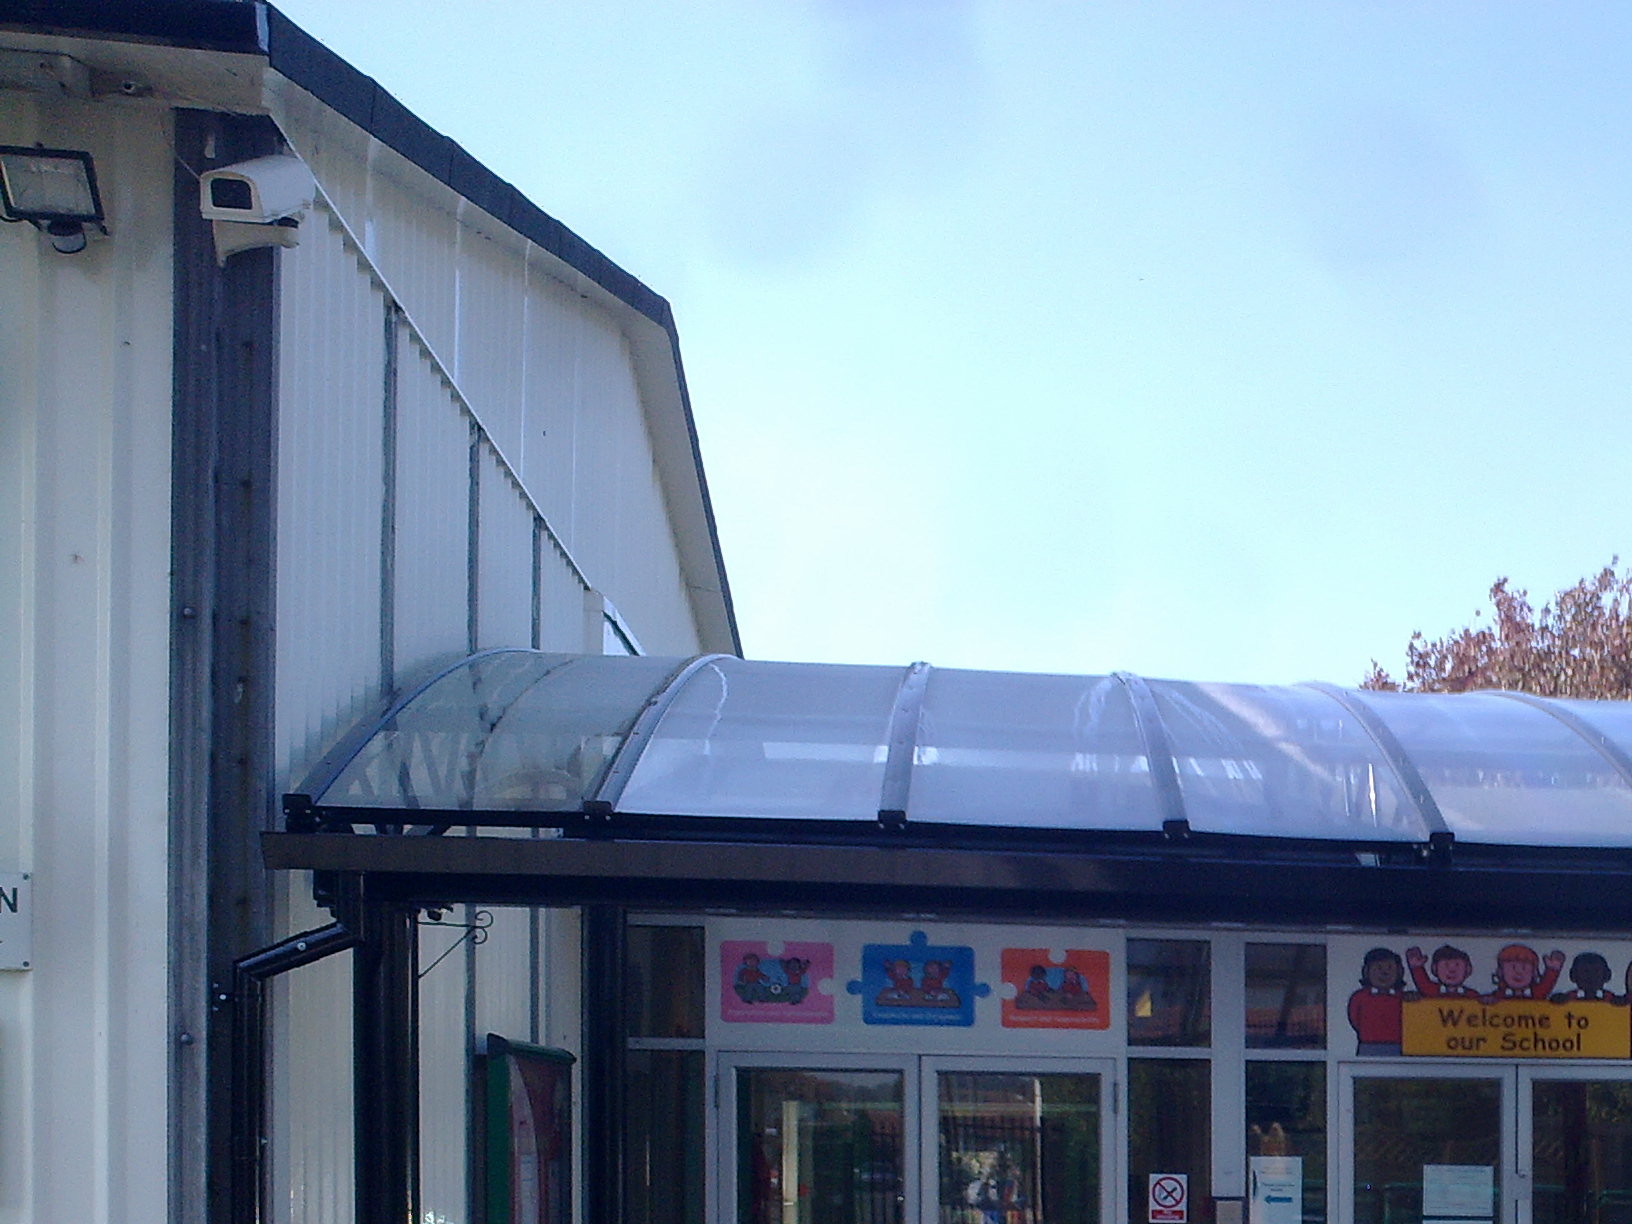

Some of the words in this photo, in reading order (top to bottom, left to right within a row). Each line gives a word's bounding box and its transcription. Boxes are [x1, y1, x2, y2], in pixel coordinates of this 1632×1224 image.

[1438, 1007, 1550, 1029] Welcome
[1564, 1011, 1589, 1030] to
[1446, 1036, 1488, 1051] our
[1501, 1031, 1582, 1052] School
